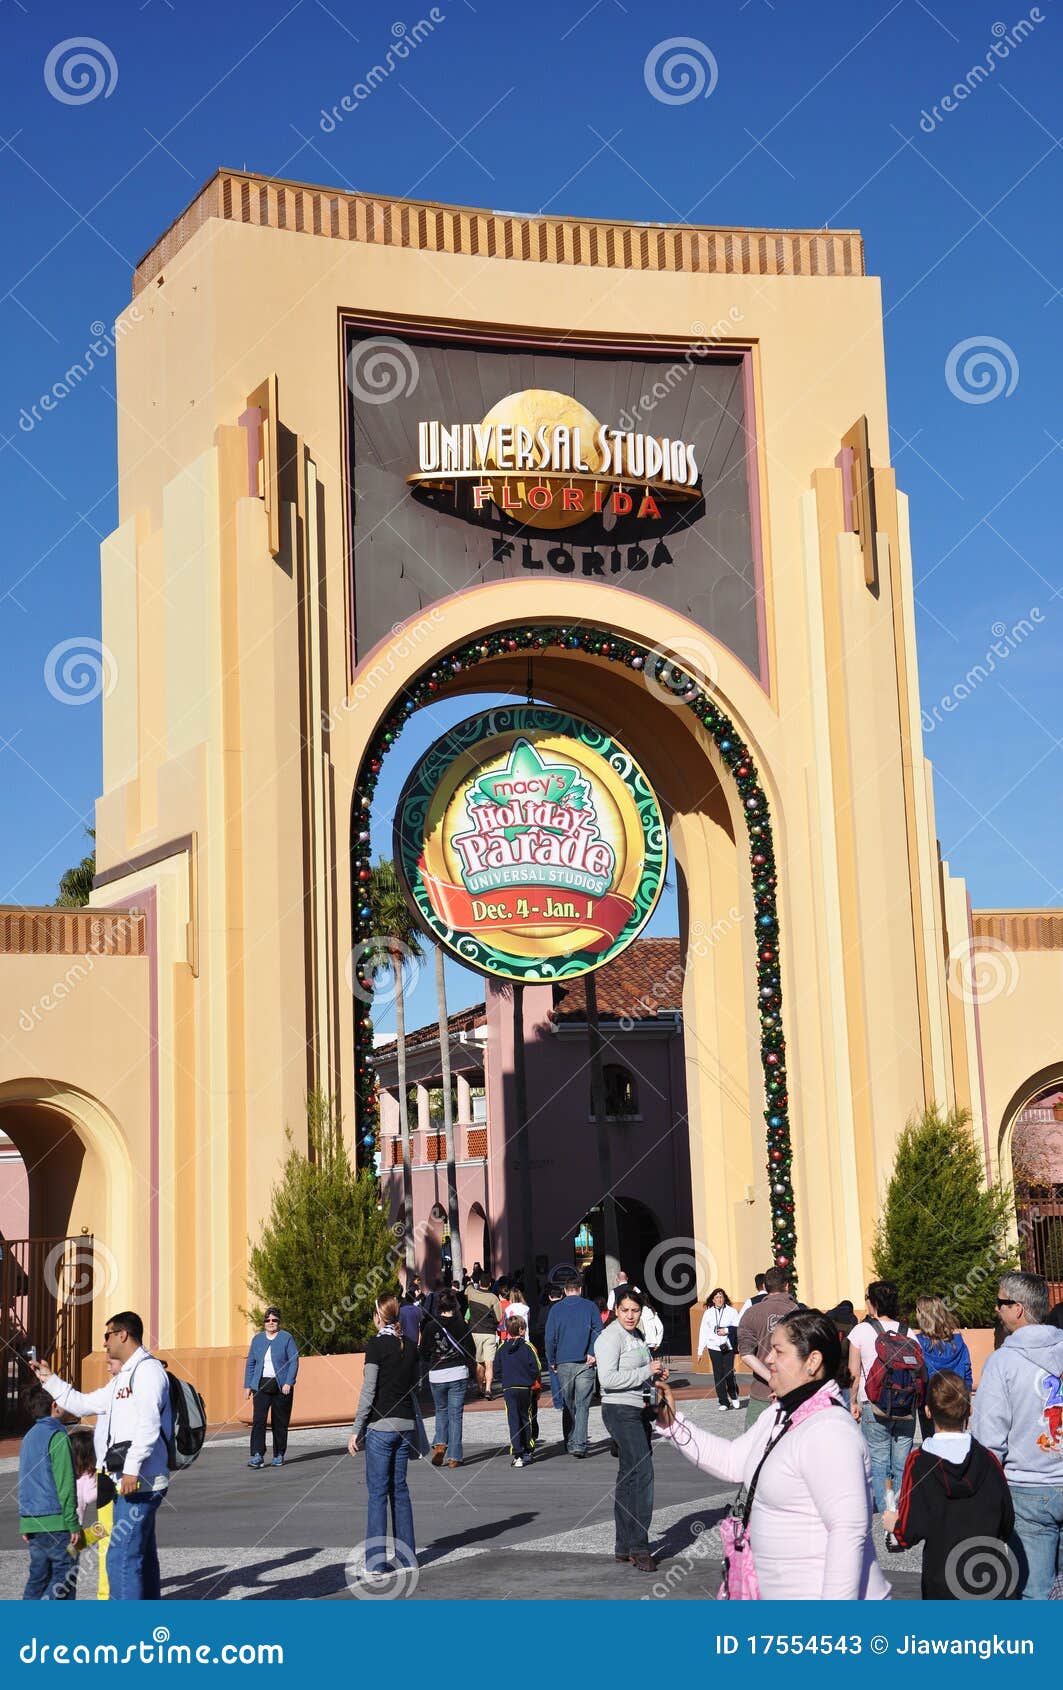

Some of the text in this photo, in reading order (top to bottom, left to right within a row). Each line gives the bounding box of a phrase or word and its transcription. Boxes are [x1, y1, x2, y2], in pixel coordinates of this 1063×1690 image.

[417, 420, 699, 487] UNIVERSAL STUDIOS
[472, 486, 662, 519] FLORIDA
[492, 773, 567, 797] macy's
[471, 799, 593, 838] Holiday
[456, 826, 612, 879] Parade
[469, 868, 605, 894] UNIVERSAL STUDIOS
[471, 900, 513, 922] Dec.
[542, 896, 581, 919] Jan.
[586, 899, 594, 919] 1
